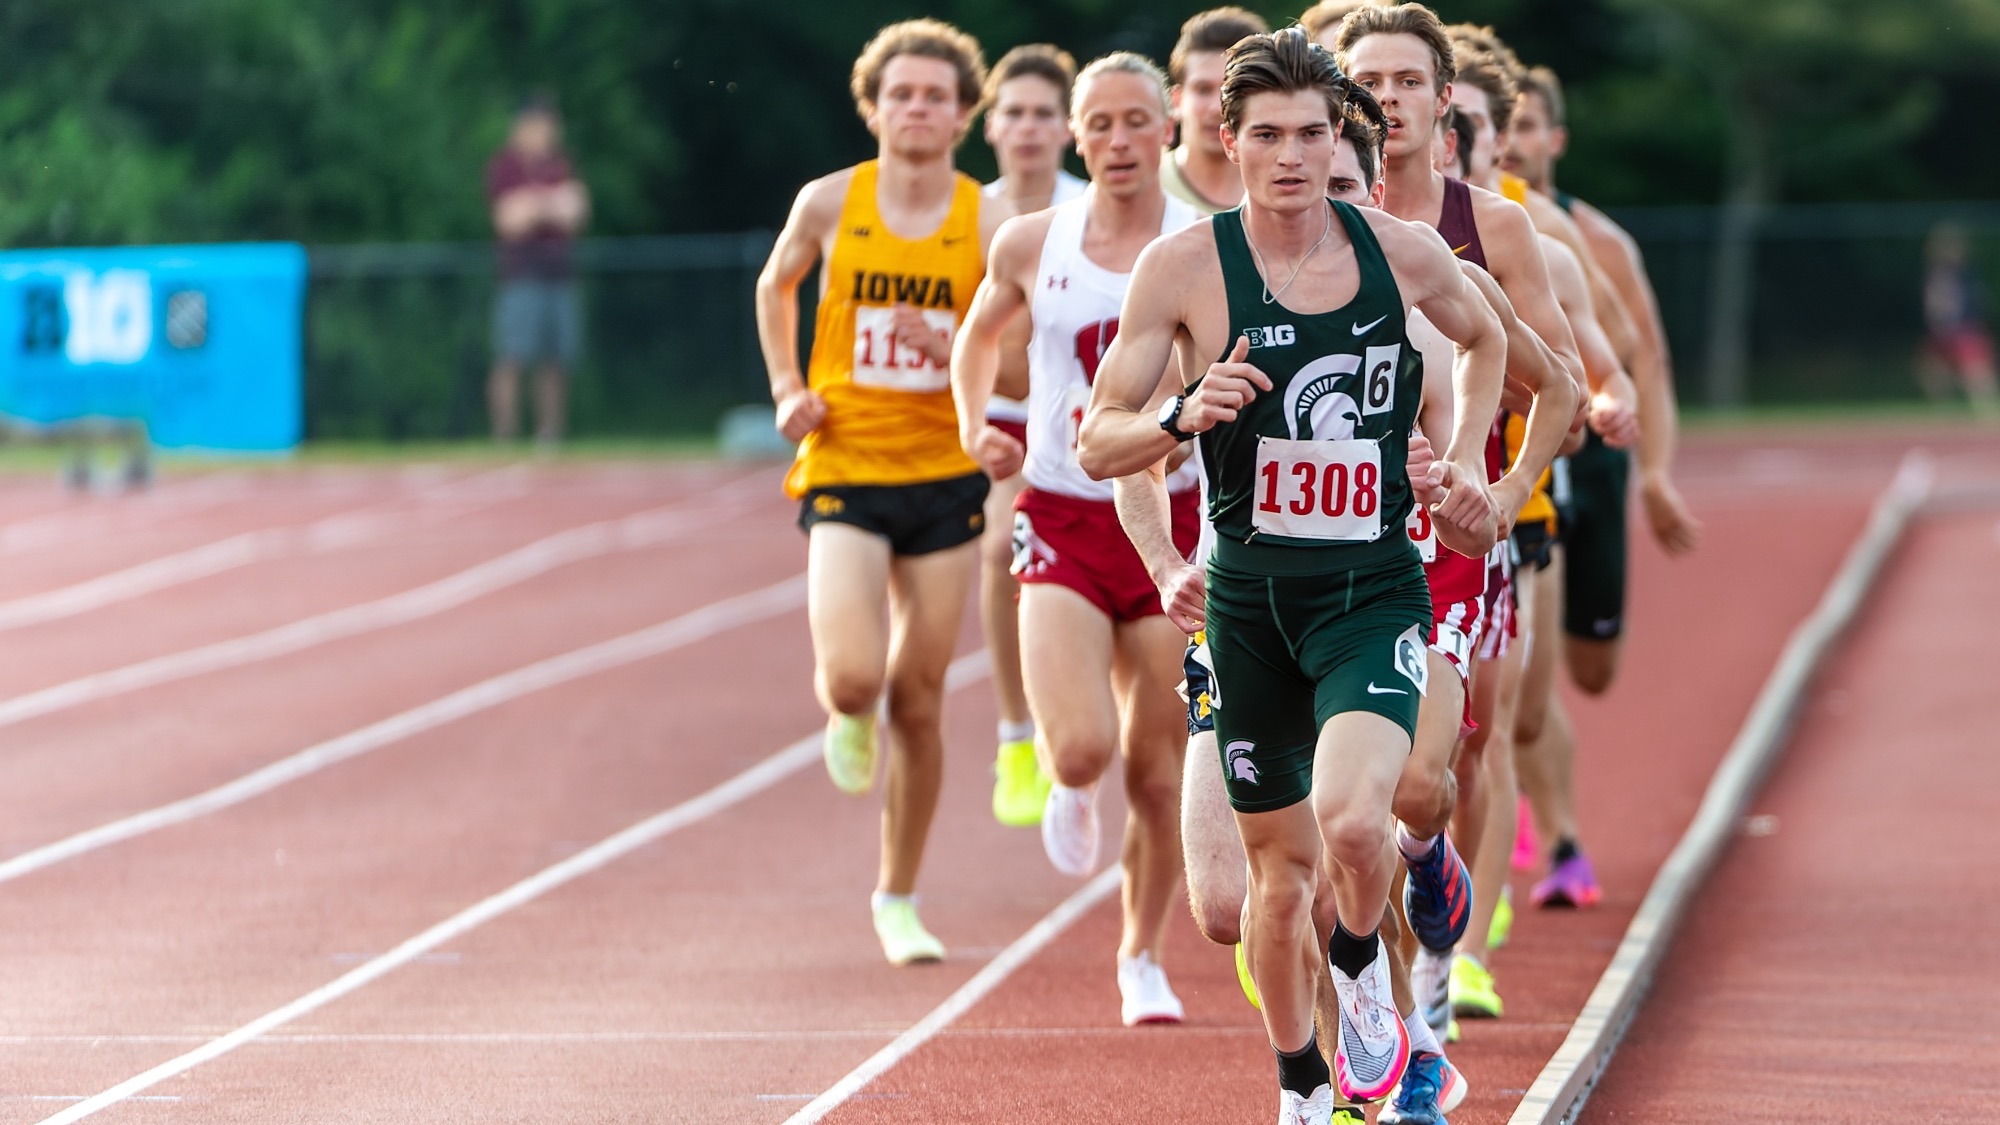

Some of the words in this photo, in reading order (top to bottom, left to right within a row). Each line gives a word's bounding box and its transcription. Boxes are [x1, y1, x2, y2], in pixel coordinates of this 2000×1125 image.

[853, 269, 954, 309] IOWA
[1368, 360, 1392, 408] 6
[1259, 460, 1377, 518] 1308
[1399, 639, 1424, 683] 6
